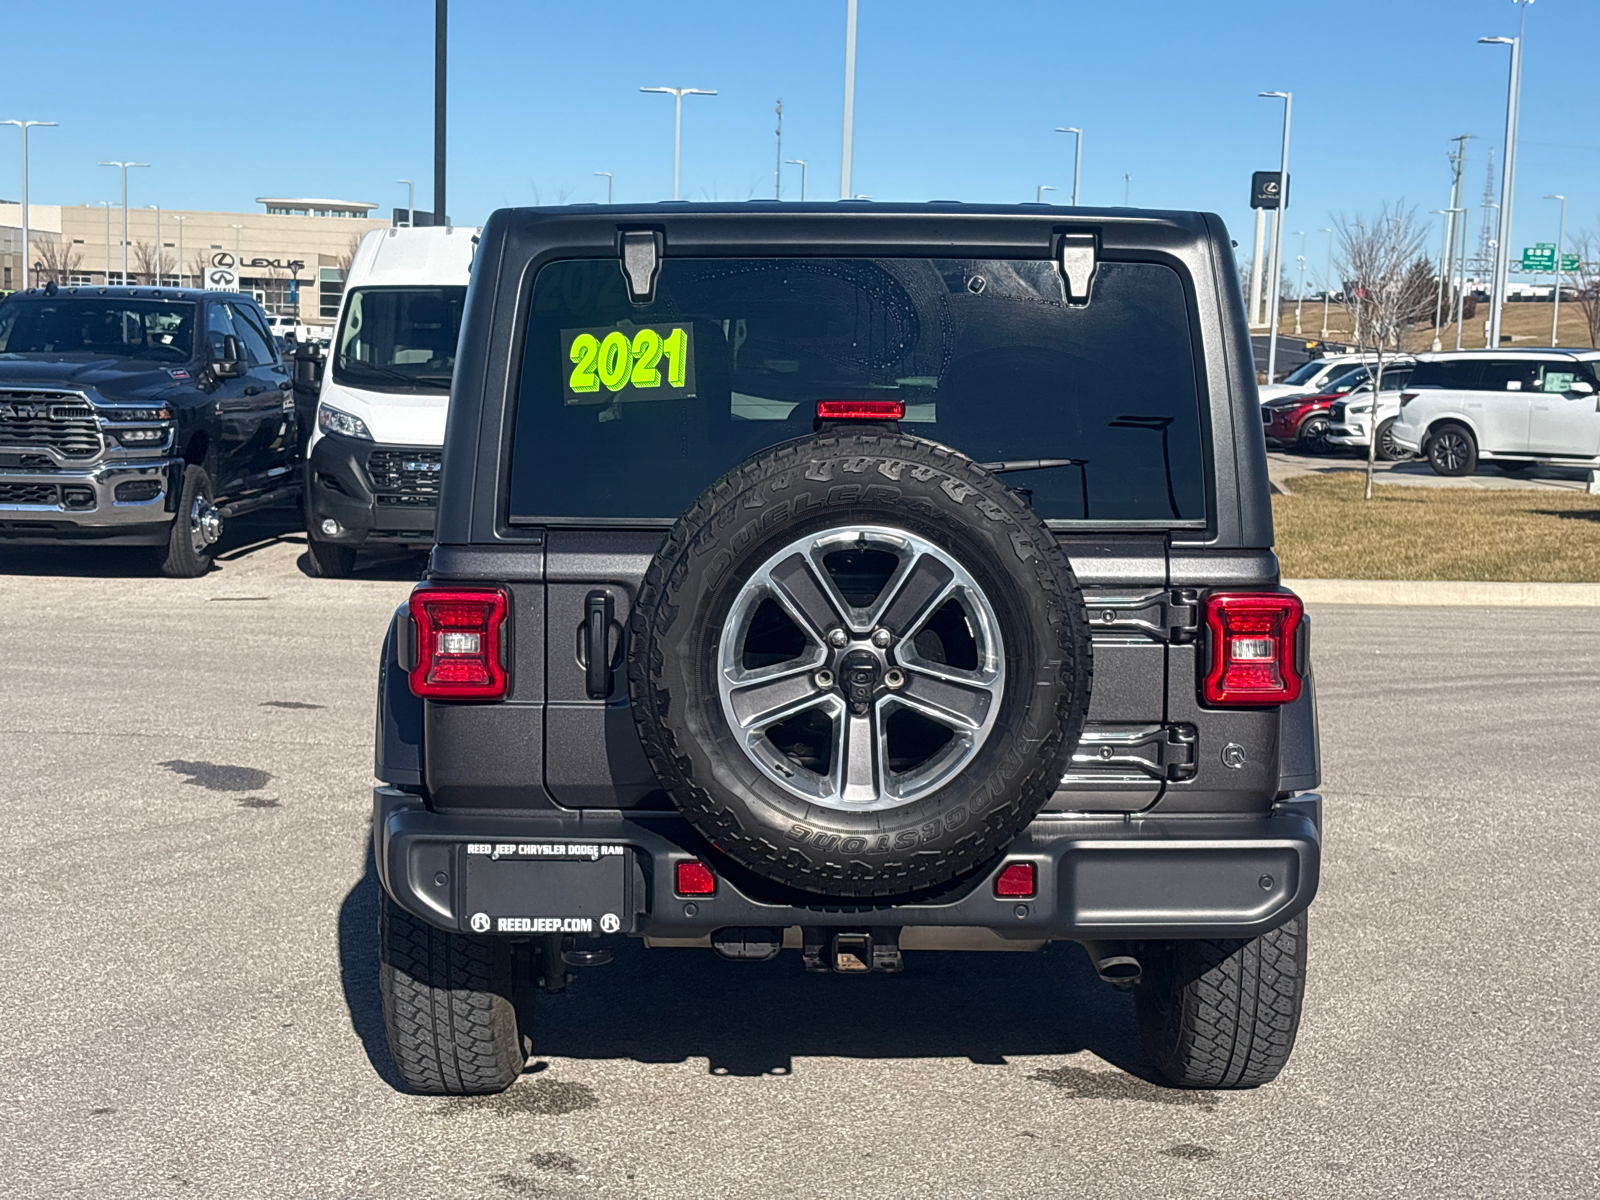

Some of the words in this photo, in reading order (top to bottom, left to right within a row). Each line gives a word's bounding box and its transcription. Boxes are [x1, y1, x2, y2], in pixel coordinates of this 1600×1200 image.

[240, 257, 305, 270] LEXUS
[569, 328, 688, 393] 2021
[0, 404, 47, 418] AM
[705, 484, 902, 591] DUELER
[784, 715, 1038, 856] BRIDGESTONE
[467, 844, 491, 854] REED
[495, 844, 516, 855] JEEP
[518, 845, 566, 855] CHRYSLER
[567, 845, 599, 855] DODGE
[601, 846, 624, 855] RAM
[498, 918, 592, 932] REEDJEEP.COM
